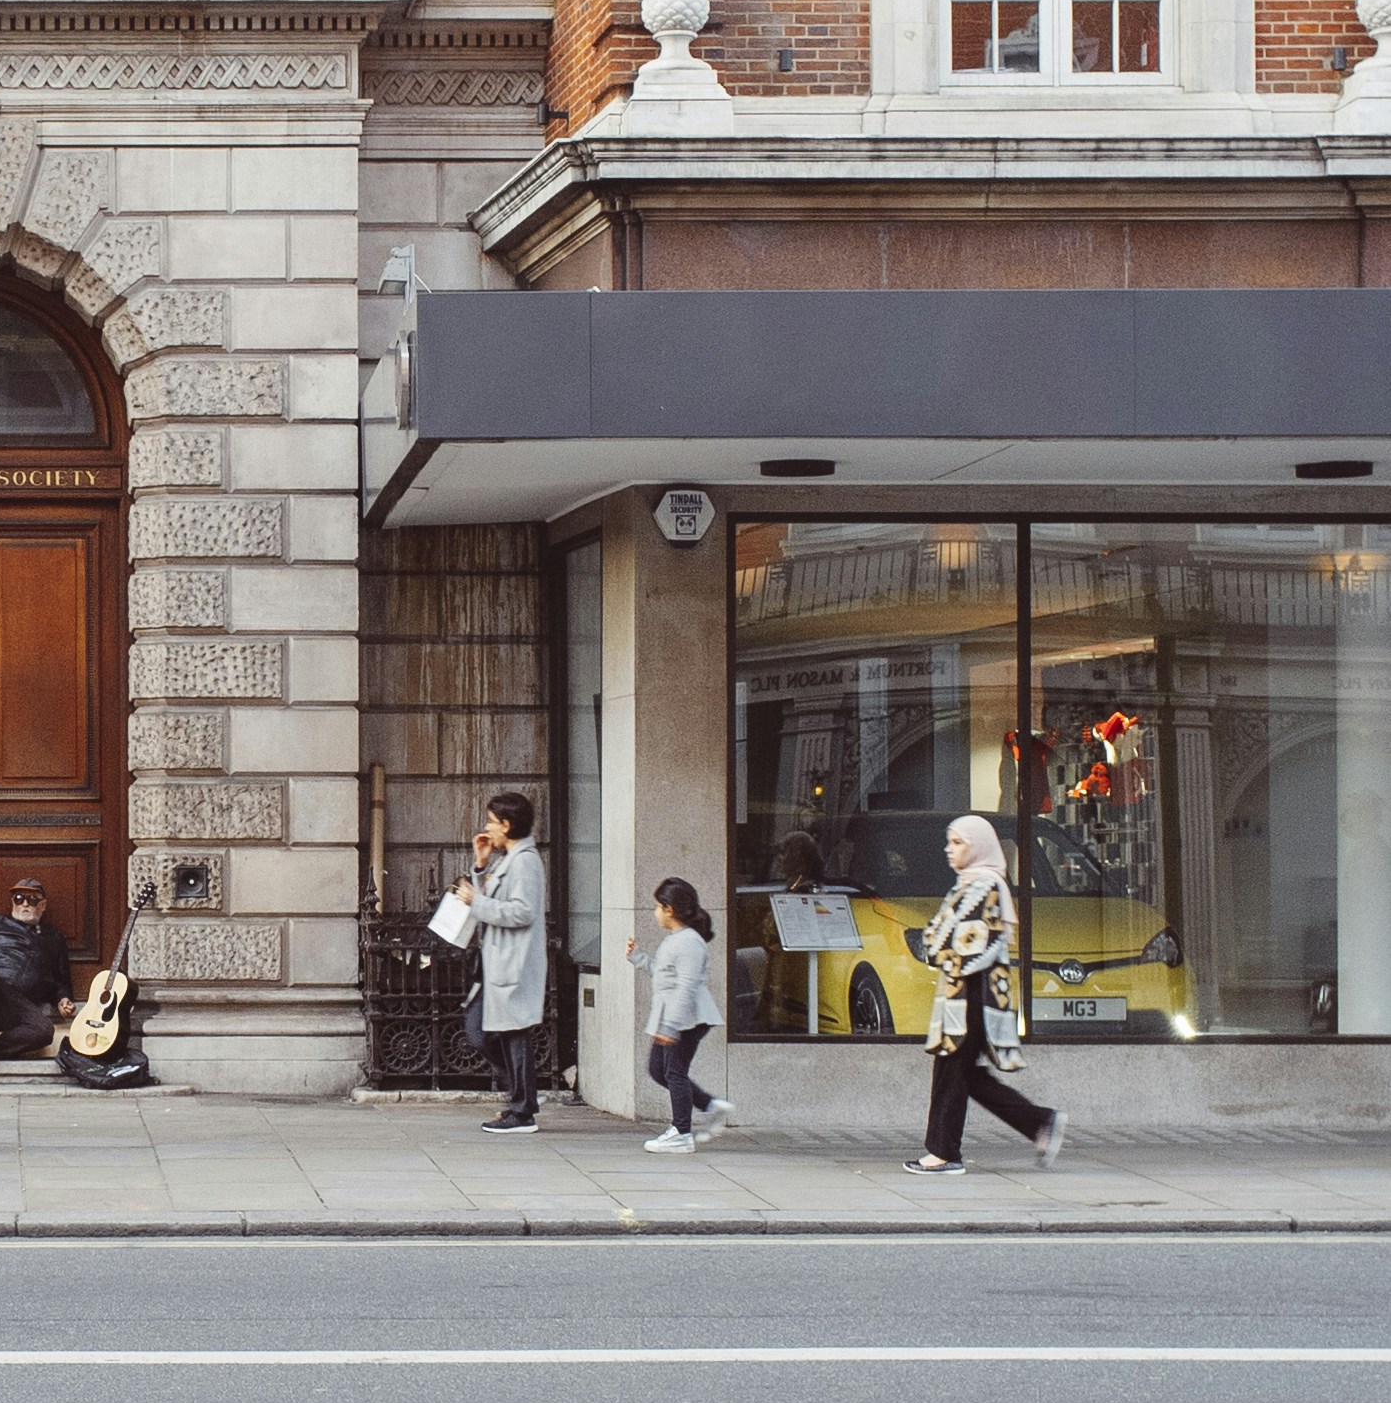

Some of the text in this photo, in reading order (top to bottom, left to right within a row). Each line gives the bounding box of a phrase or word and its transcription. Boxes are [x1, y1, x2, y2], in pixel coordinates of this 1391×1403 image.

[670, 494, 703, 506] TINDALL
[670, 506, 703, 514] SECURITY
[1063, 1000, 1097, 1017] MG3
